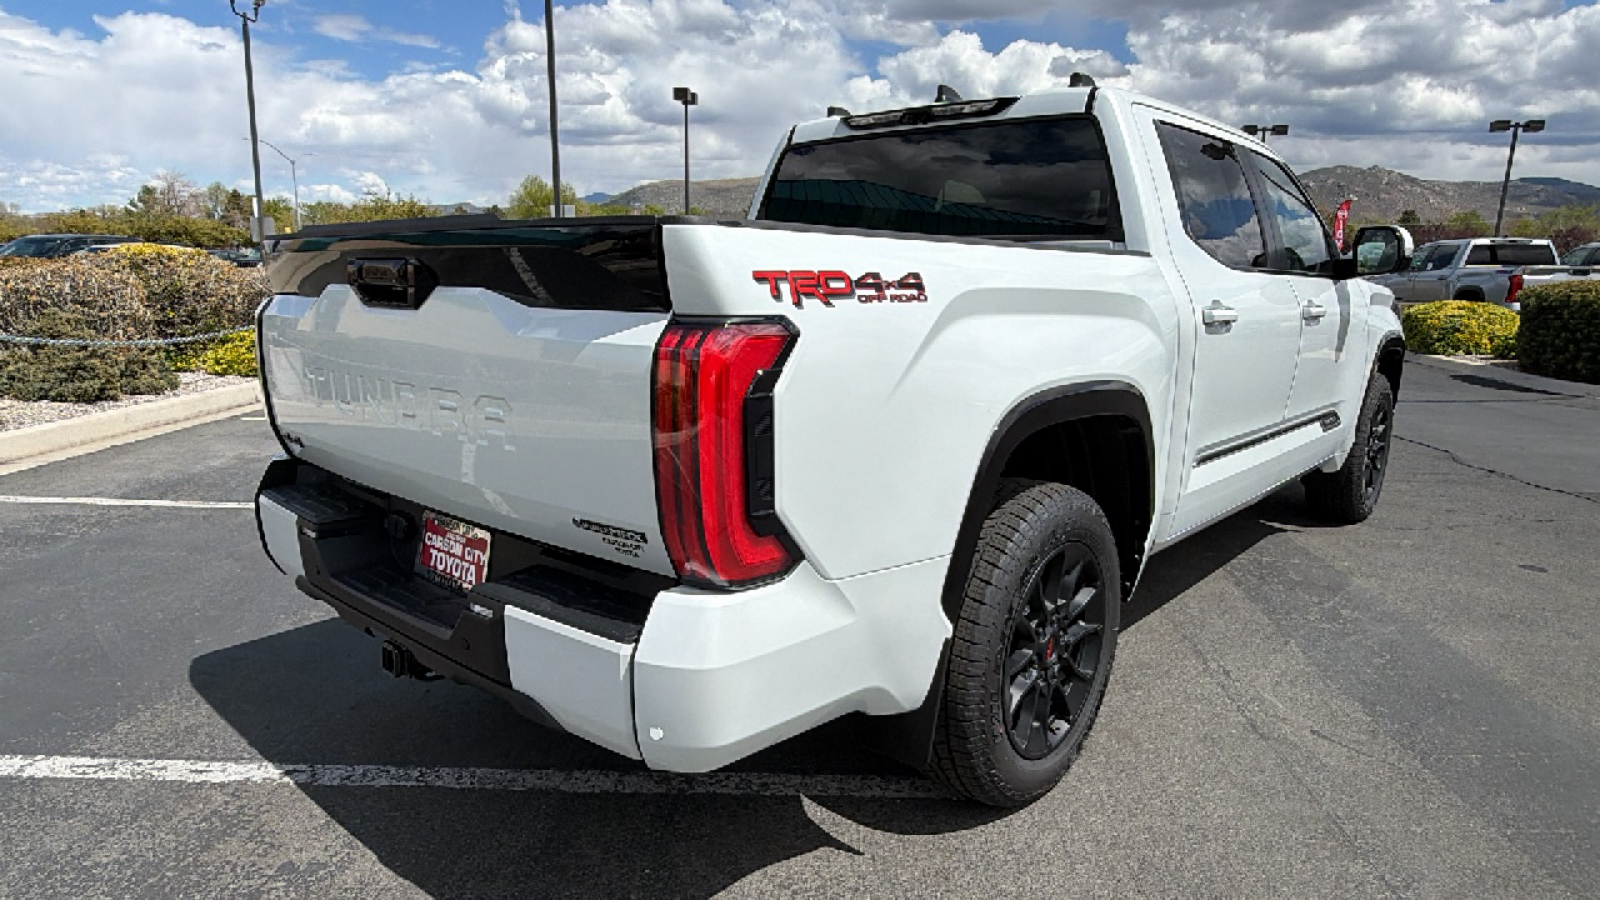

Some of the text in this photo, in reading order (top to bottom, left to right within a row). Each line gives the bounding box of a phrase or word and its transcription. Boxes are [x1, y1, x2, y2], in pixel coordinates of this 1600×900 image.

[752, 270, 854, 309] TRD
[857, 293, 928, 304] OFF ROAD
[304, 365, 516, 450] TUNDRA
[425, 531, 463, 558] CARSON
[464, 547, 486, 566] CITY
[430, 548, 476, 586] TOYOTA
